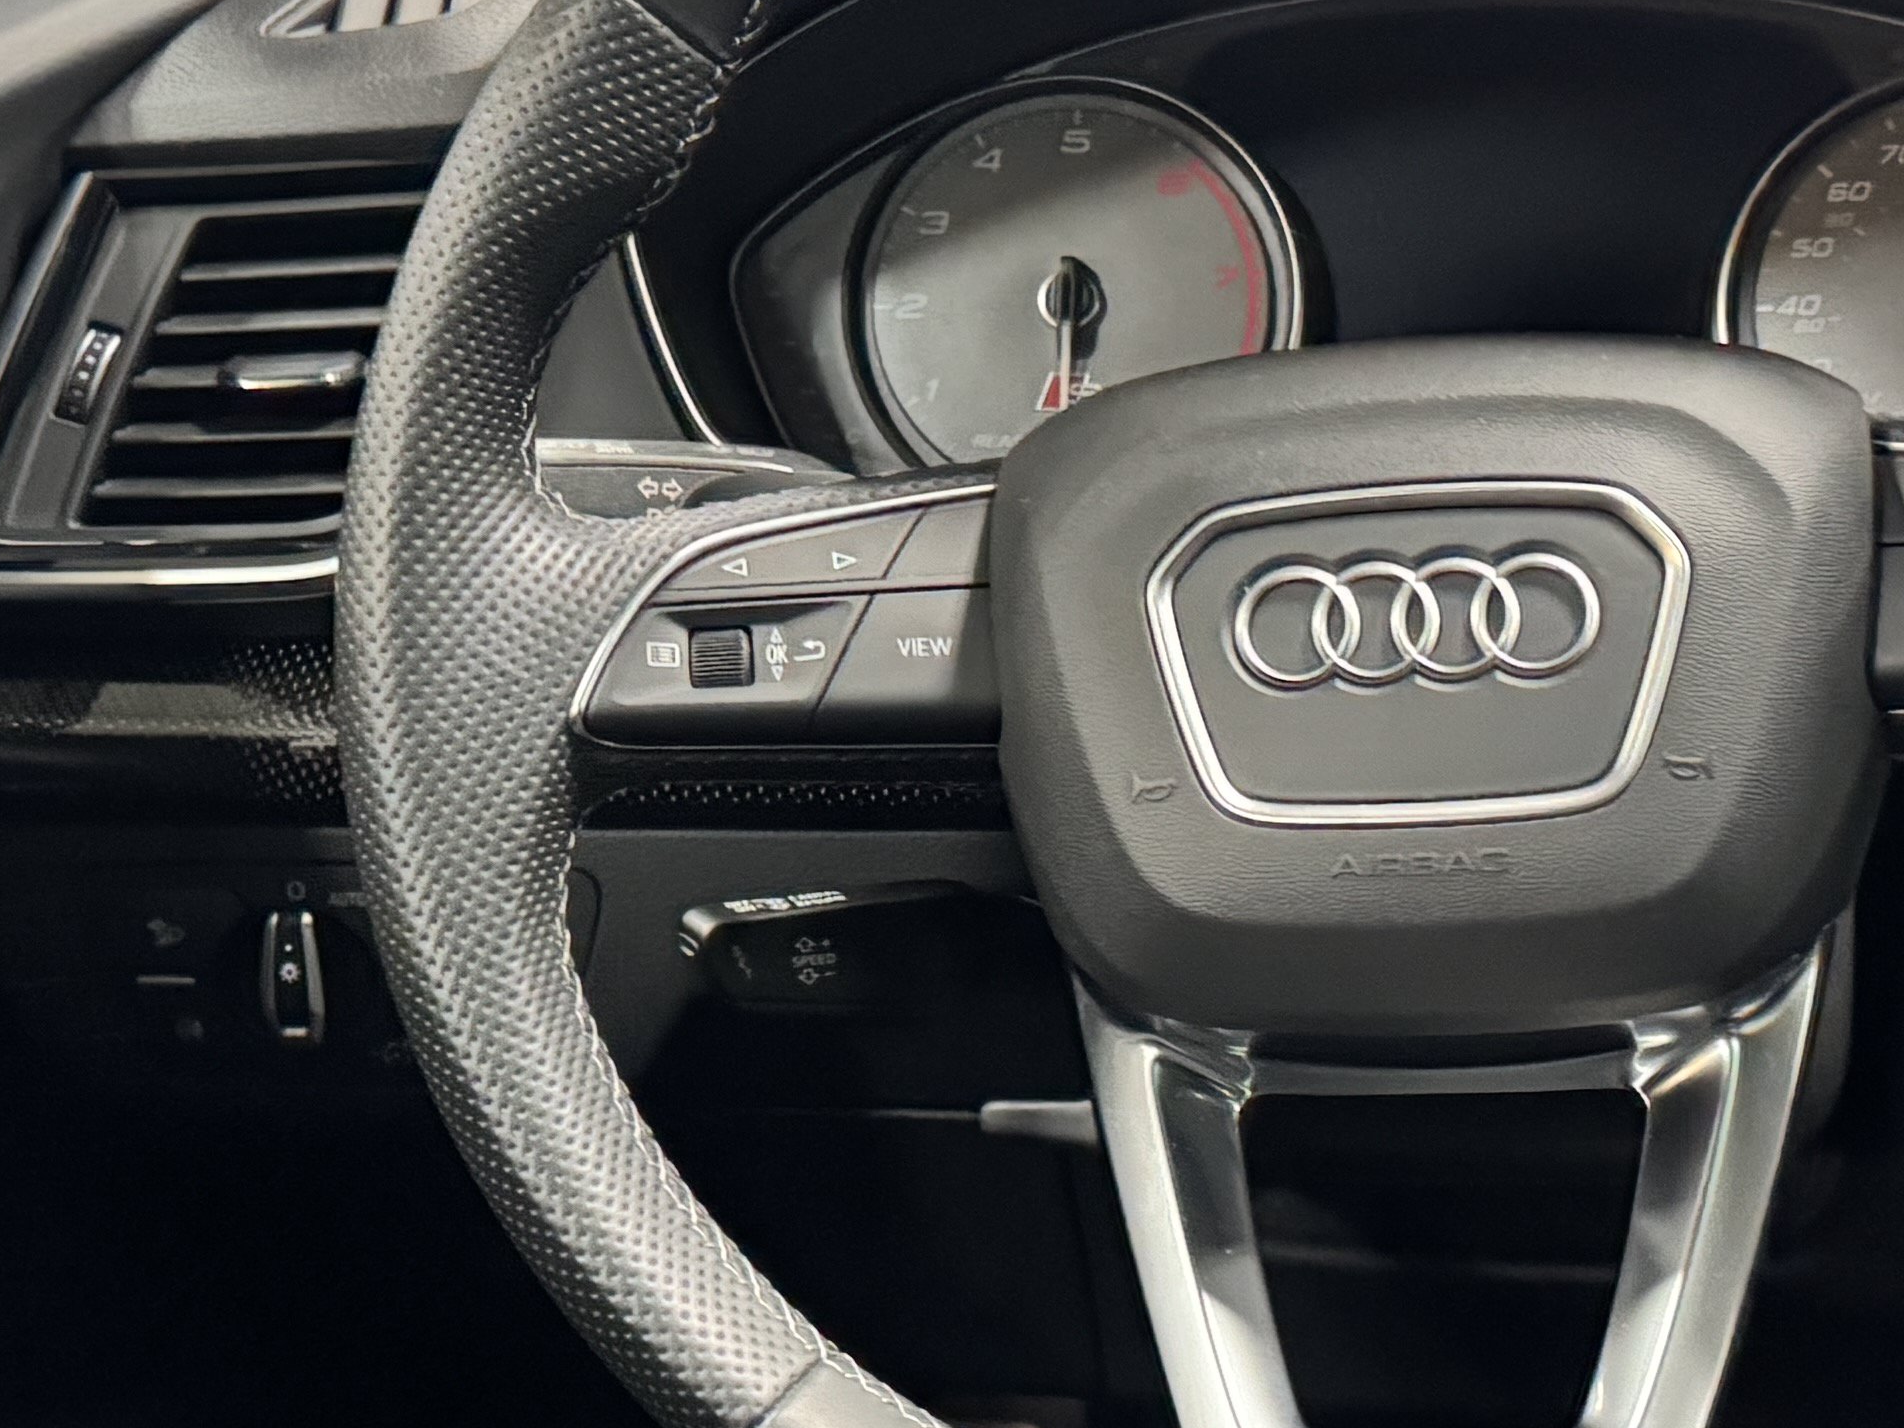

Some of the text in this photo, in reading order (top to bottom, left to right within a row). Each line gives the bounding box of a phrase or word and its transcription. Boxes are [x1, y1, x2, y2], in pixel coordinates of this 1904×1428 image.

[1060, 128, 1092, 154] 5
[972, 147, 1004, 172] 4
[1826, 180, 1872, 203] 60
[917, 209, 951, 235] 3
[1789, 236, 1836, 259] 50
[894, 294, 929, 320] 2
[1773, 294, 1822, 316] 40
[926, 378, 940, 402] 1
[764, 642, 789, 665] OK
[896, 636, 954, 658] VIEW
[791, 952, 838, 969] SPEED
